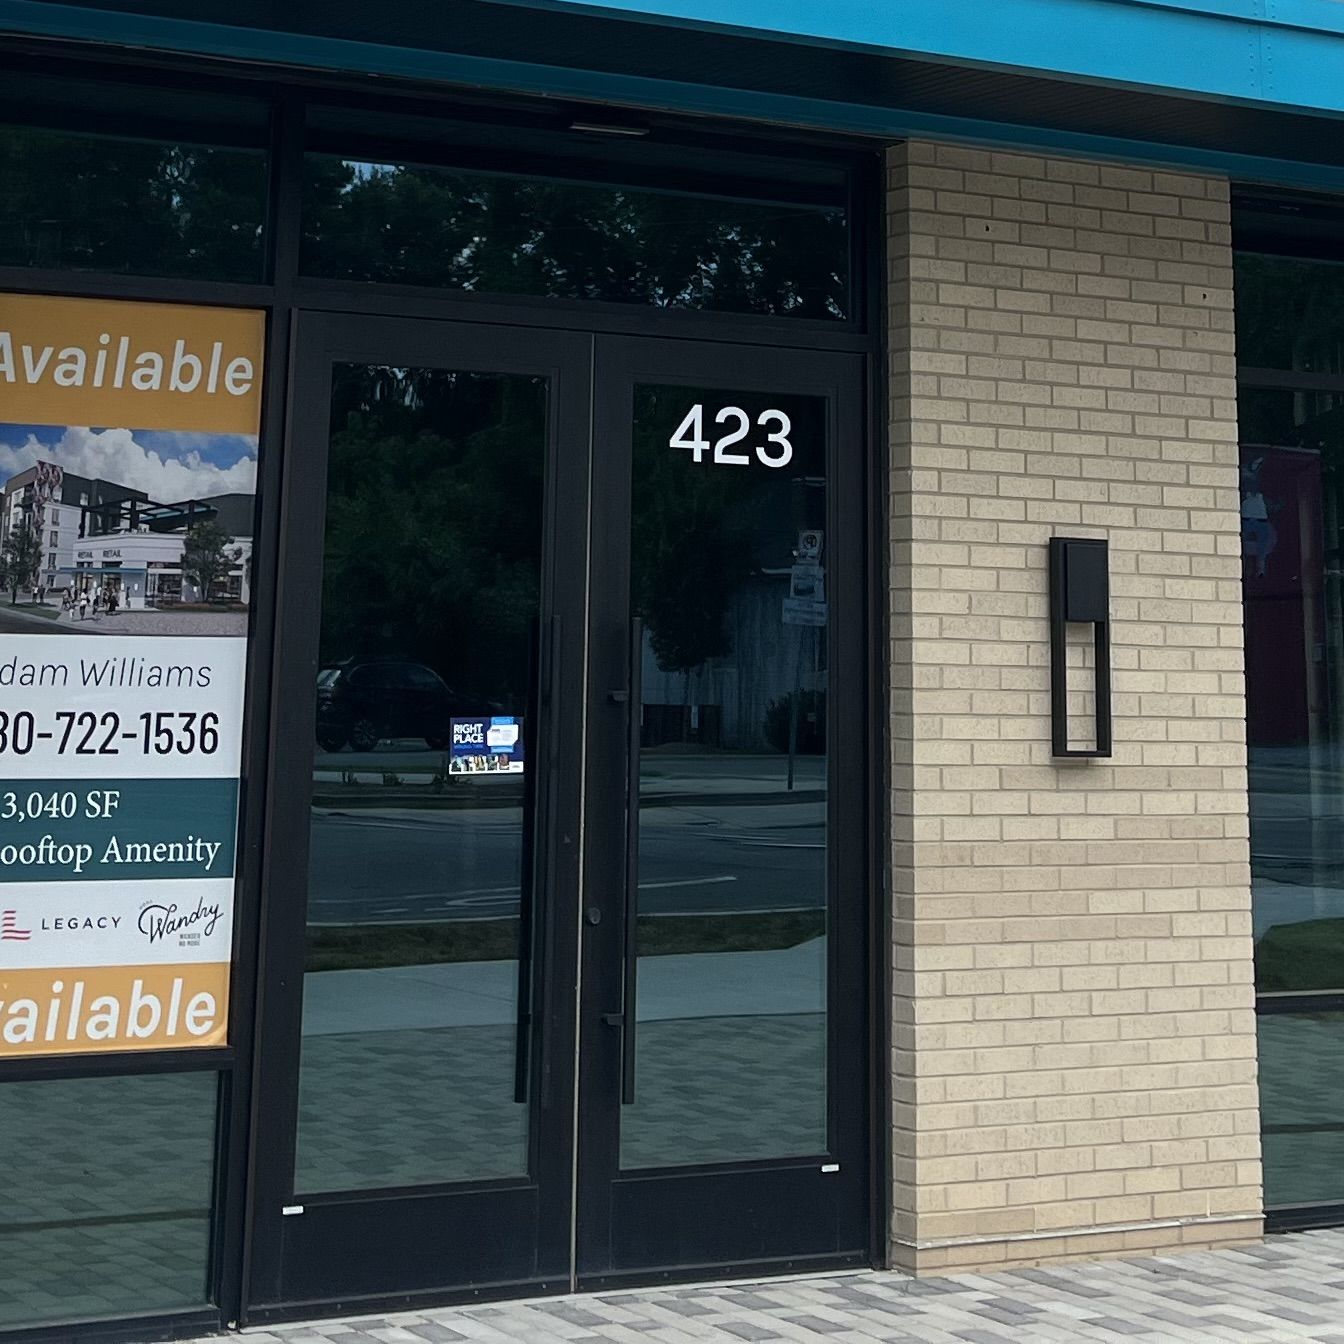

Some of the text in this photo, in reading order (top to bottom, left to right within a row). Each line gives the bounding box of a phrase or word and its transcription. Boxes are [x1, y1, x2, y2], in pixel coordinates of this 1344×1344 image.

[669, 404, 793, 468] 423
[80, 657, 212, 687] Williams
[453, 723, 483, 734] RIGHT
[453, 733, 484, 744] PLACE
[1, 791, 77, 822] 3,040
[84, 790, 121, 818] SF
[100, 835, 222, 870] Amenity
[41, 916, 122, 931] LEGACY
[137, 896, 224, 944] Wandry
